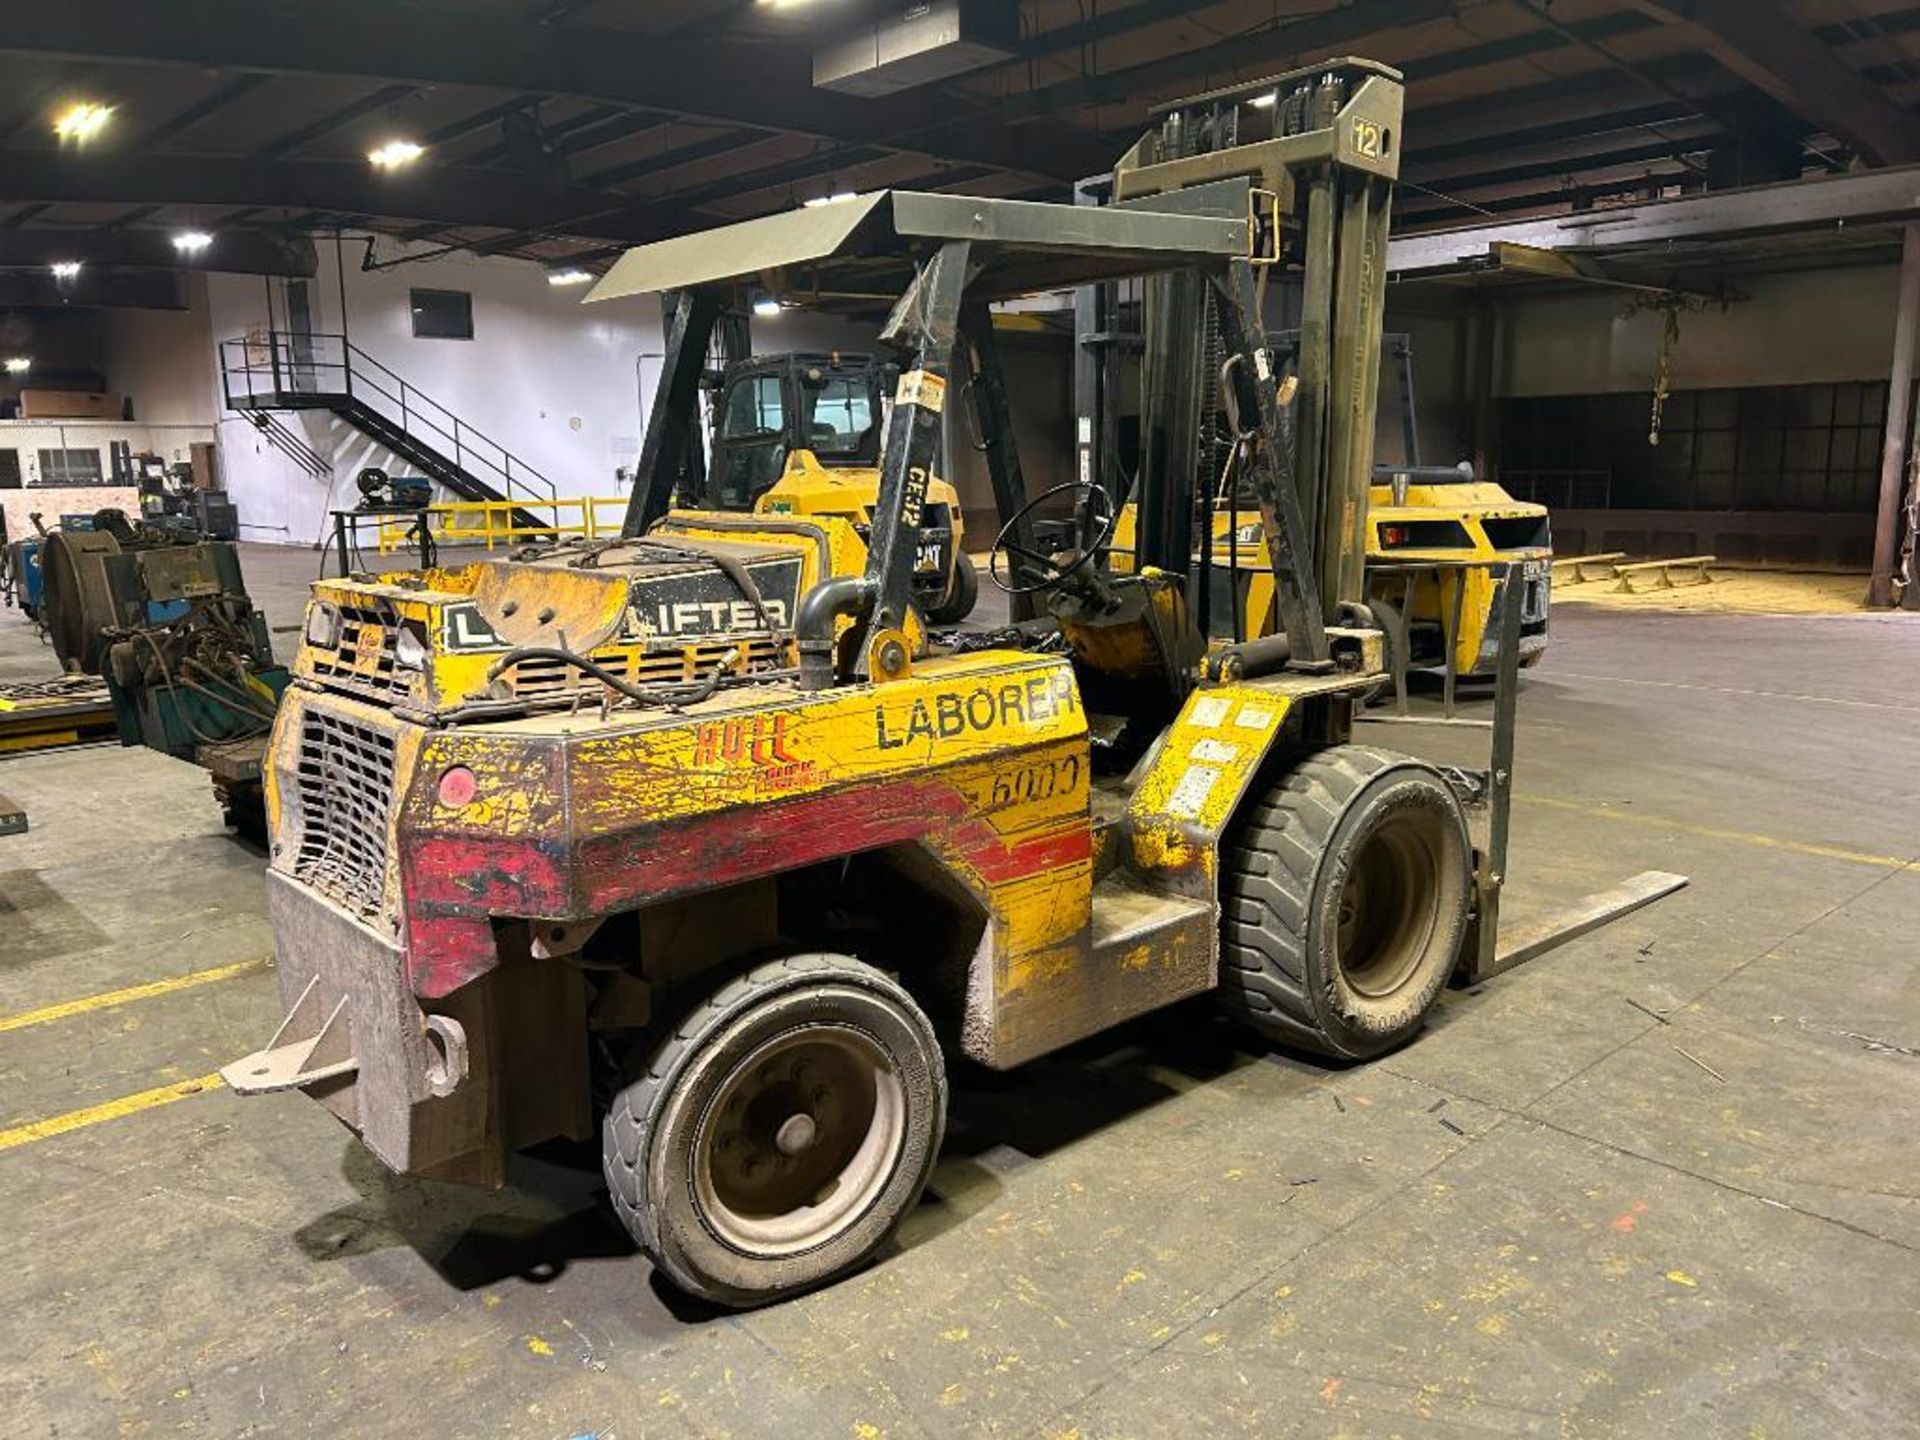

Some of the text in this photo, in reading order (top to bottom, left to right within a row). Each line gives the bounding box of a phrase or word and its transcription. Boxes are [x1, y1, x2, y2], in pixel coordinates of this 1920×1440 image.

[1354, 123, 1376, 157] 12
[913, 544, 941, 571] CAT
[876, 672, 1076, 750] LABORER
